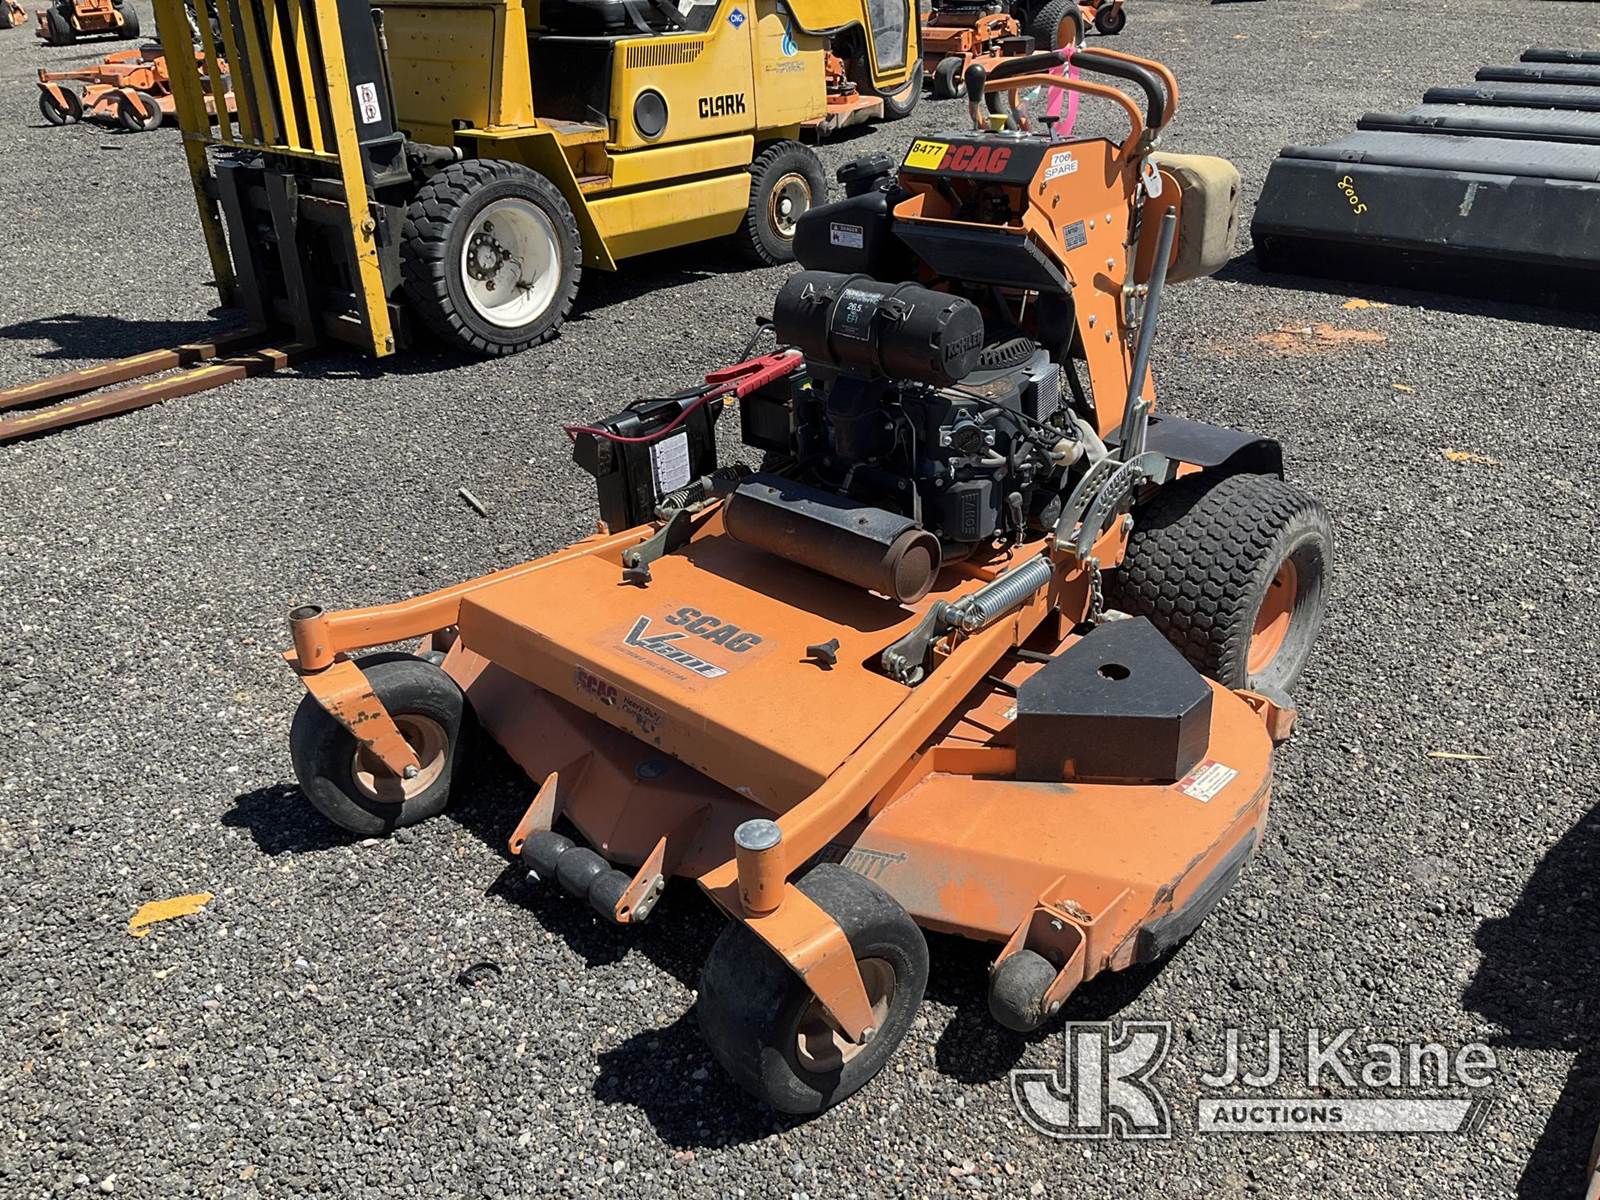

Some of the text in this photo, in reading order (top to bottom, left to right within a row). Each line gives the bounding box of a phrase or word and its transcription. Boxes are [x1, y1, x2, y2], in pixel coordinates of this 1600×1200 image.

[730, 14, 744, 23] CNG
[698, 93, 746, 119] CLARK
[912, 143, 942, 156] 8477
[1045, 162, 1076, 179] SPARE
[665, 607, 763, 652] SCAG
